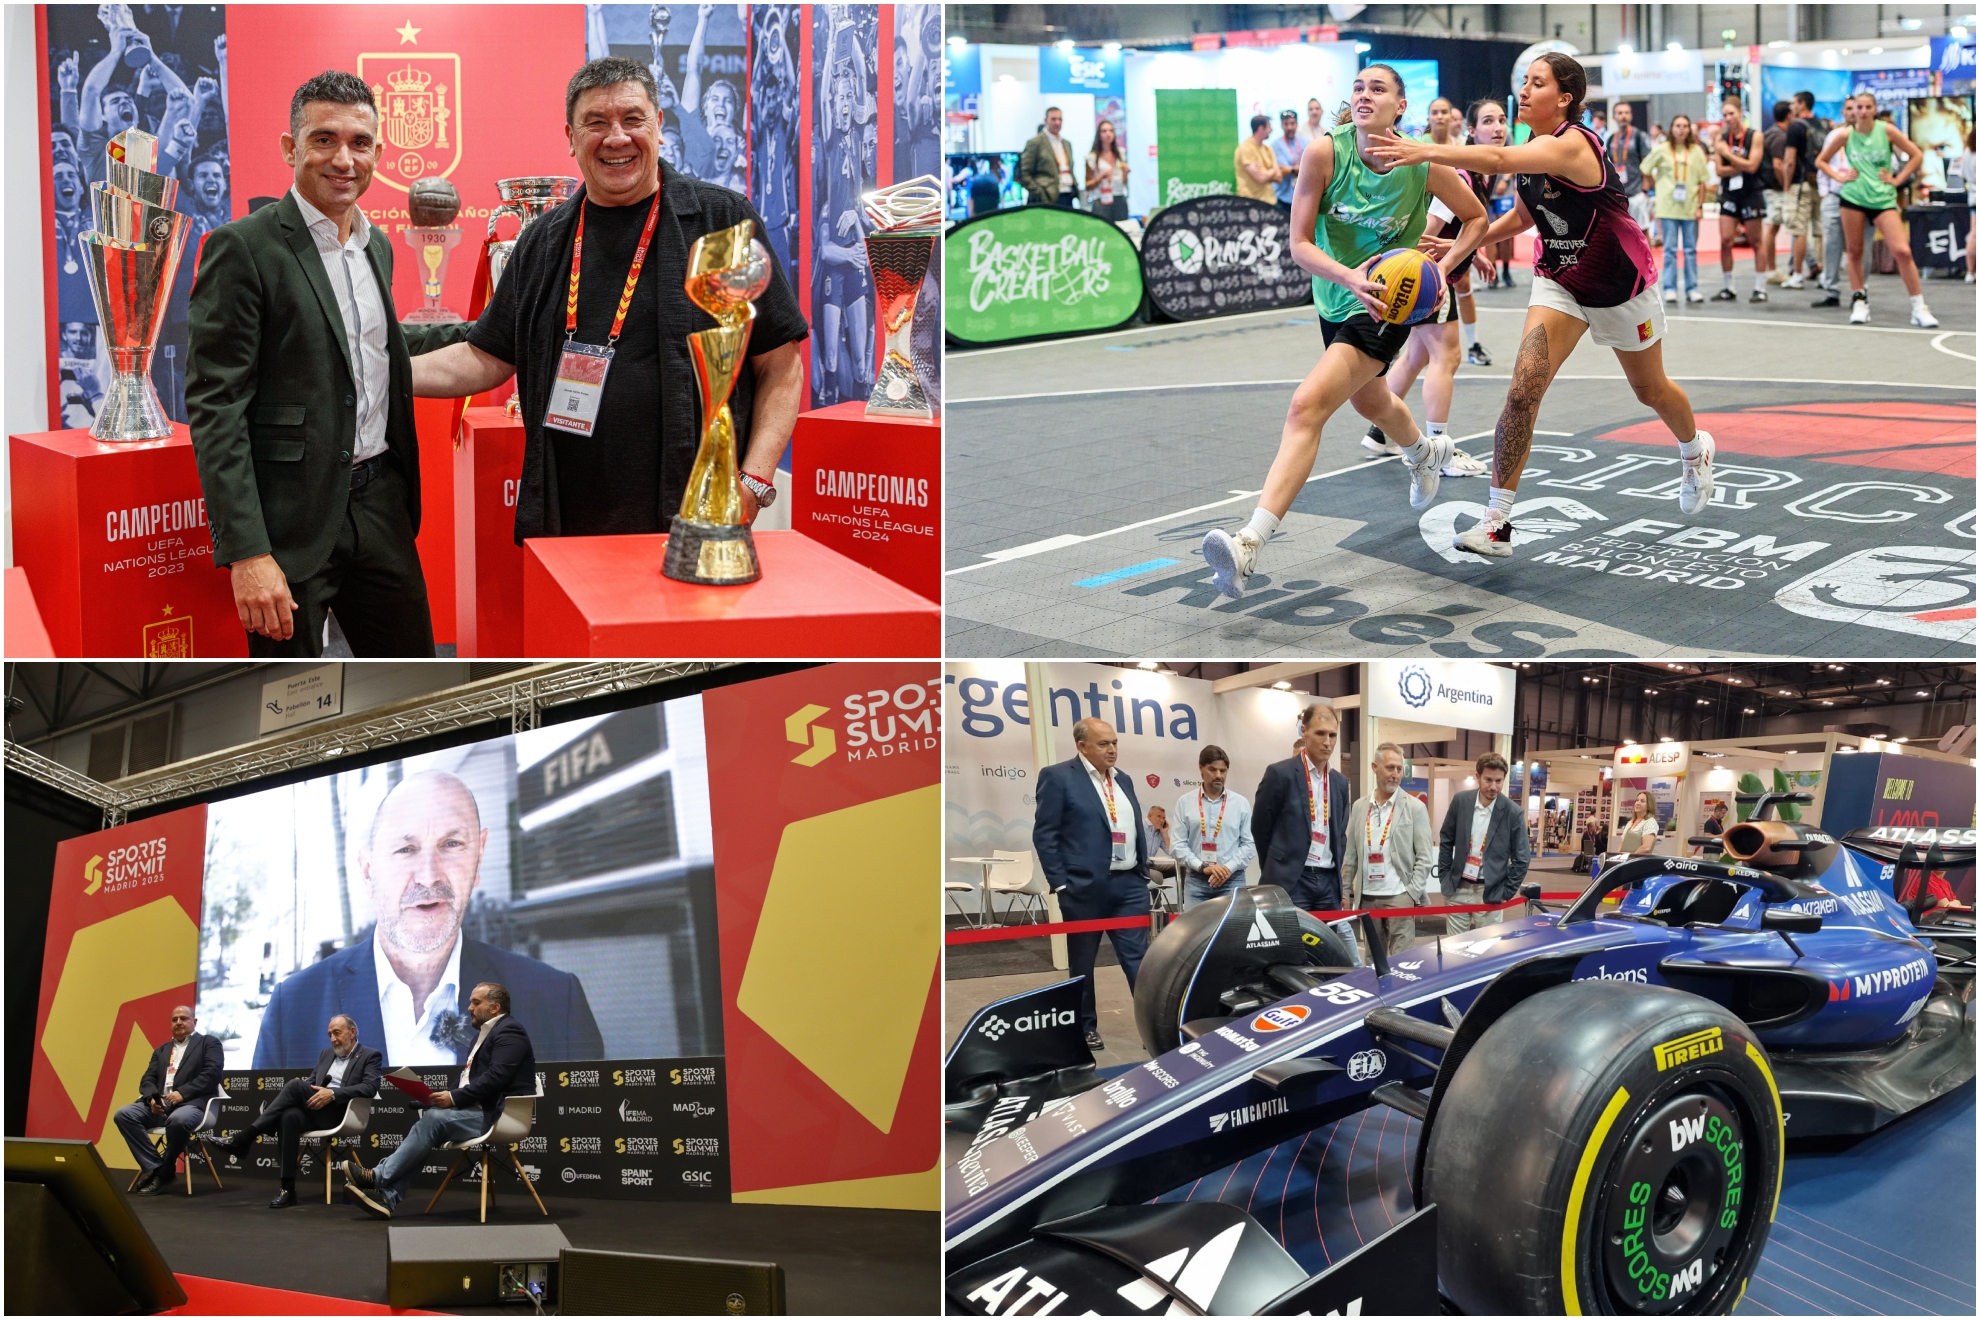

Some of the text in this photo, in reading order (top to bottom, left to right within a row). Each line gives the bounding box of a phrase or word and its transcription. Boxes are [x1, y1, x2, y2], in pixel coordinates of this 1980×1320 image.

[422, 234, 446, 244] 1930
[1388, 277, 1416, 320] Wilson
[553, 416, 586, 430] VISITANTE
[816, 468, 929, 508] CAMPEONAS
[106, 498, 210, 542] CAMPEONE
[812, 511, 934, 536] NATIONS LEAGUE
[852, 505, 890, 518] UEFA
[148, 537, 184, 552] UEFA
[852, 528, 890, 543] 2024
[1602, 518, 1832, 562] FBM
[104, 545, 214, 574] NATIONS LEAGU
[1558, 543, 1769, 579] BALONCESTO
[1582, 536, 1791, 572] FEDERACION
[148, 563, 185, 578] 2023
[1530, 551, 1746, 590] MADRID
[287, 676, 320, 690] Puerta Este
[1436, 683, 1493, 706] Argentina
[285, 693, 332, 712] Pabellón 14
[848, 737, 937, 762] MADRID
[1648, 752, 1680, 764] ADESP
[542, 730, 614, 797] FIFA
[981, 764, 1026, 780] indigo
[106, 837, 167, 867] SPORTS
[105, 855, 166, 884] SUMMIT
[1676, 862, 1698, 871] airia
[1735, 869, 1760, 879] KEEPER
[1880, 864, 1896, 880] 55
[104, 873, 165, 894] MADRID 2025
[1246, 940, 1280, 949] ATLASSIAN
[1856, 958, 1929, 998] MYPROTEIN
[1309, 982, 1374, 1004] 55
[1014, 1008, 1076, 1032] airia
[1264, 1009, 1300, 1028] Gulf
[1214, 1026, 1260, 1052] KOMATSU
[1653, 1026, 1724, 1072] PIRELLI
[1154, 1066, 1180, 1088] SCORES
[1230, 1096, 1290, 1128] FANCAPITAL
[1062, 1114, 1087, 1138] VAST
[621, 1168, 648, 1178] SPAIN
[682, 1171, 712, 1182] GSIC
[1669, 1114, 1743, 1229] bw SCORES
[1623, 1181, 1670, 1300] SCORES
[1668, 1258, 1703, 1300] bw
